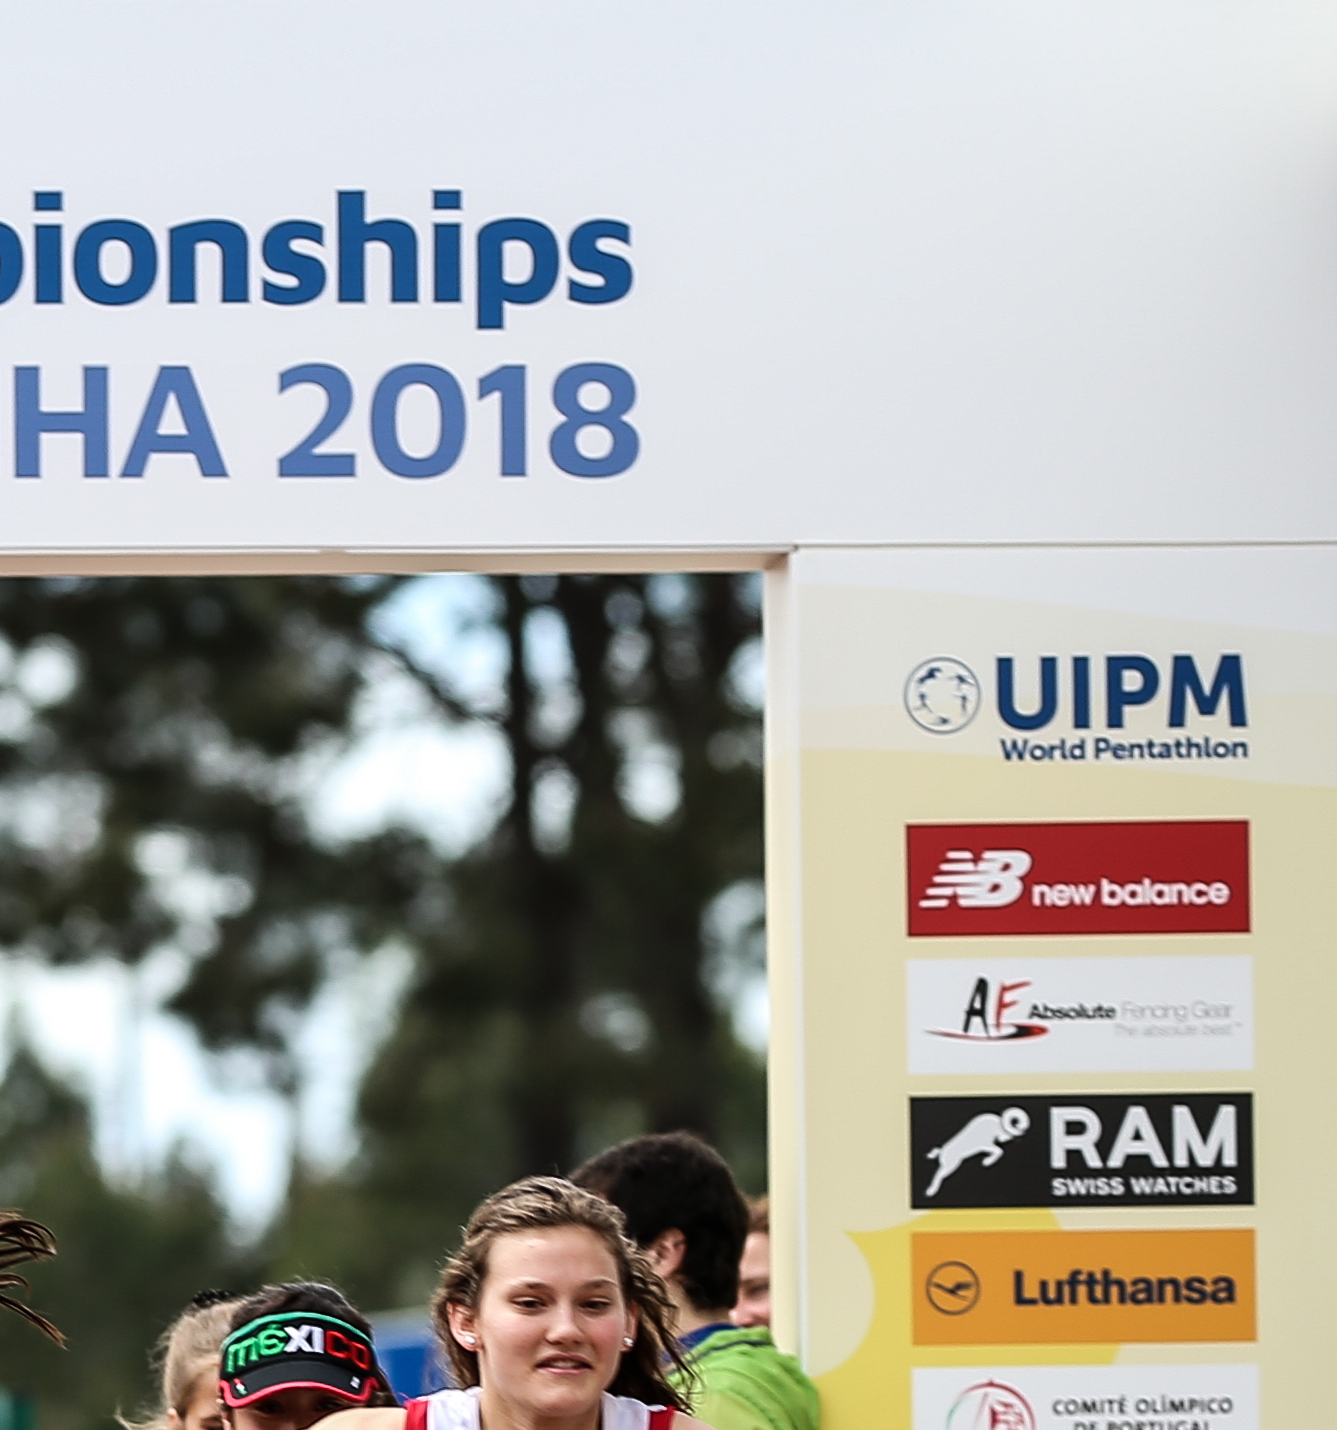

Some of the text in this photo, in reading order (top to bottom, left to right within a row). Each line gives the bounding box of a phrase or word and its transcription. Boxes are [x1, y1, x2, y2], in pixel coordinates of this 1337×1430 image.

[277, 362, 641, 480] 2018
[996, 654, 1248, 731] UIPM
[1000, 736, 1249, 761] World Pentathlon
[1031, 877, 1231, 907] new balance
[1028, 999, 1234, 1022] Absolute Fencing Gear
[1049, 1105, 1238, 1169] RAM
[1052, 1176, 1238, 1196] SWISS WATCHES
[1013, 1269, 1237, 1306] Lufthansa
[1052, 1393, 1234, 1416] COMITÉ OLÍMPICO
